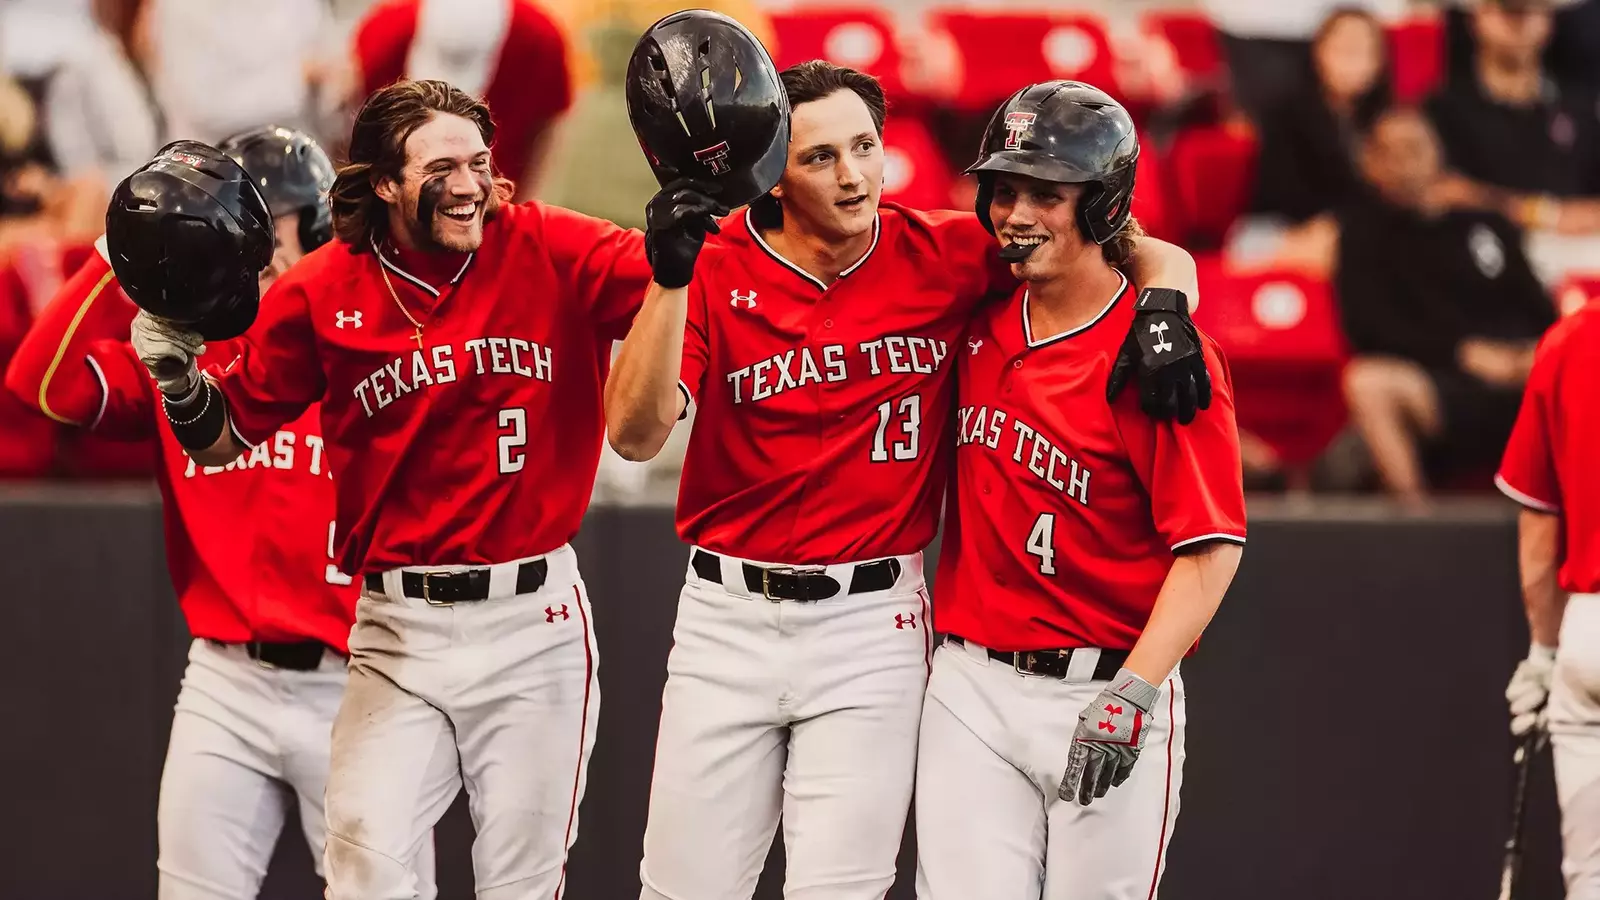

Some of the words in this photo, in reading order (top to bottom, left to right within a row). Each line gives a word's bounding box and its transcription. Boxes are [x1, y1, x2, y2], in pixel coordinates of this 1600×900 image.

[353, 344, 457, 418] TEXAS
[464, 337, 552, 382] TECH
[727, 344, 848, 404] TEXAS
[860, 336, 948, 376] TECH
[498, 408, 527, 474] 2
[871, 394, 920, 461] 13
[957, 406, 1007, 449] XAS
[1013, 419, 1091, 505] TECH
[1027, 513, 1056, 575] 4
